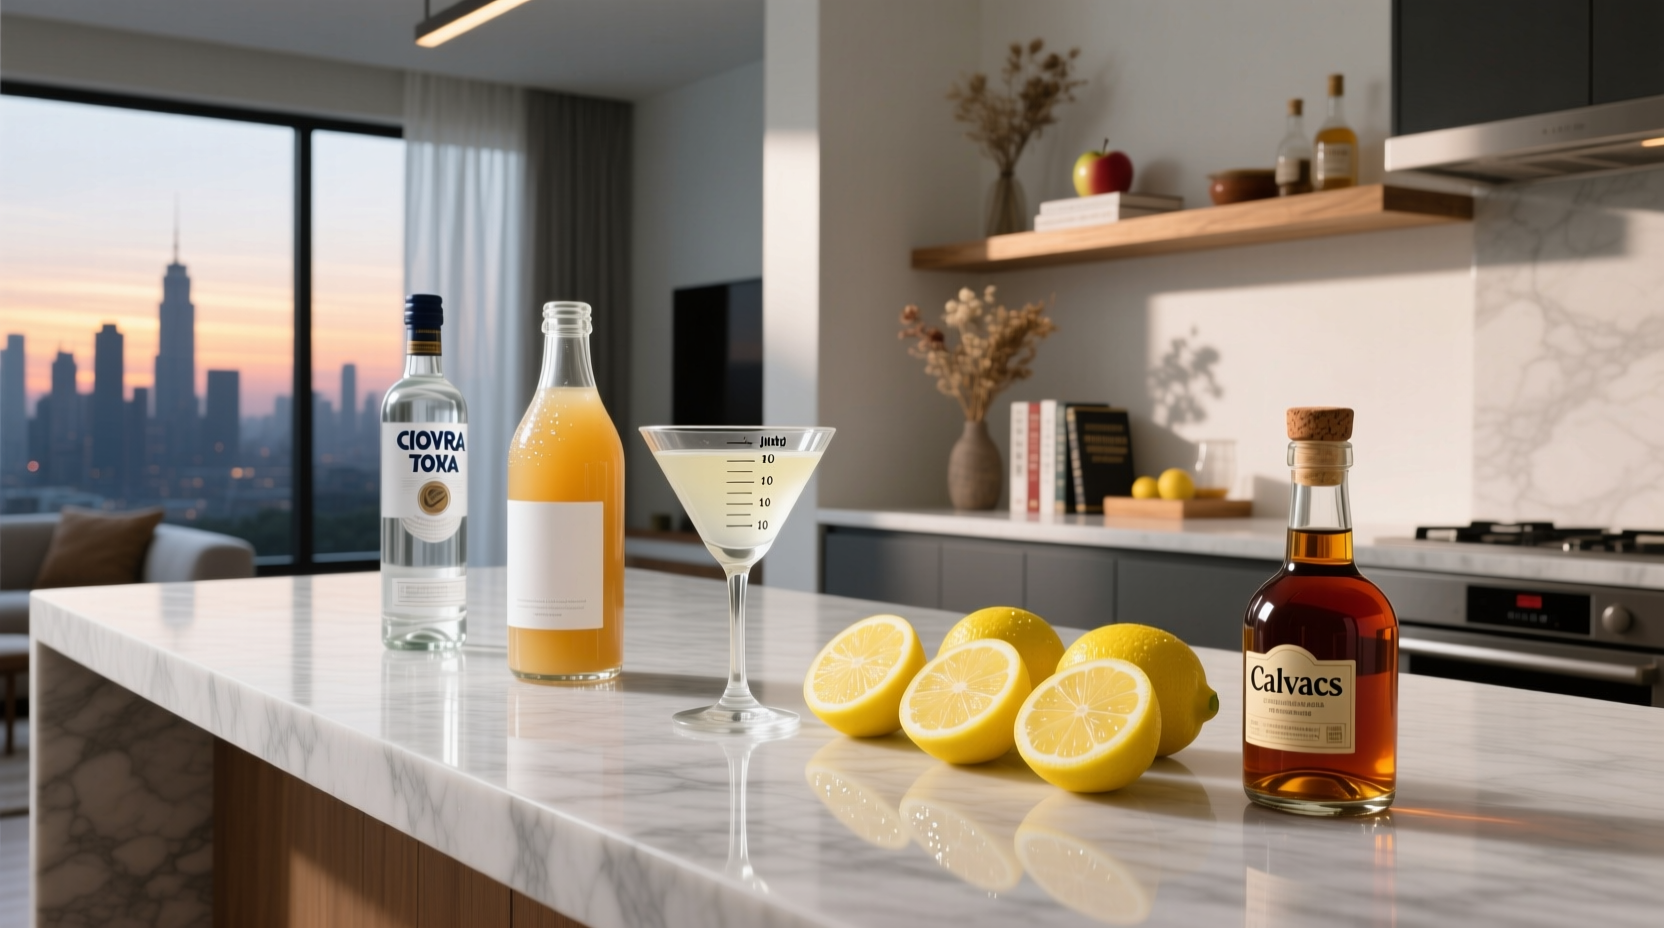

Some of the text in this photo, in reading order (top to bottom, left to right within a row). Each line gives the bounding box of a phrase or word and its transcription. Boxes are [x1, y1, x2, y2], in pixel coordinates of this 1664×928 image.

[397, 430, 465, 451] CIOVRA
[762, 454, 775, 463] 10
[761, 476, 773, 485] 10
[759, 498, 771, 507] 10
[758, 520, 768, 530] 10
[1251, 665, 1342, 696] Calvacs
